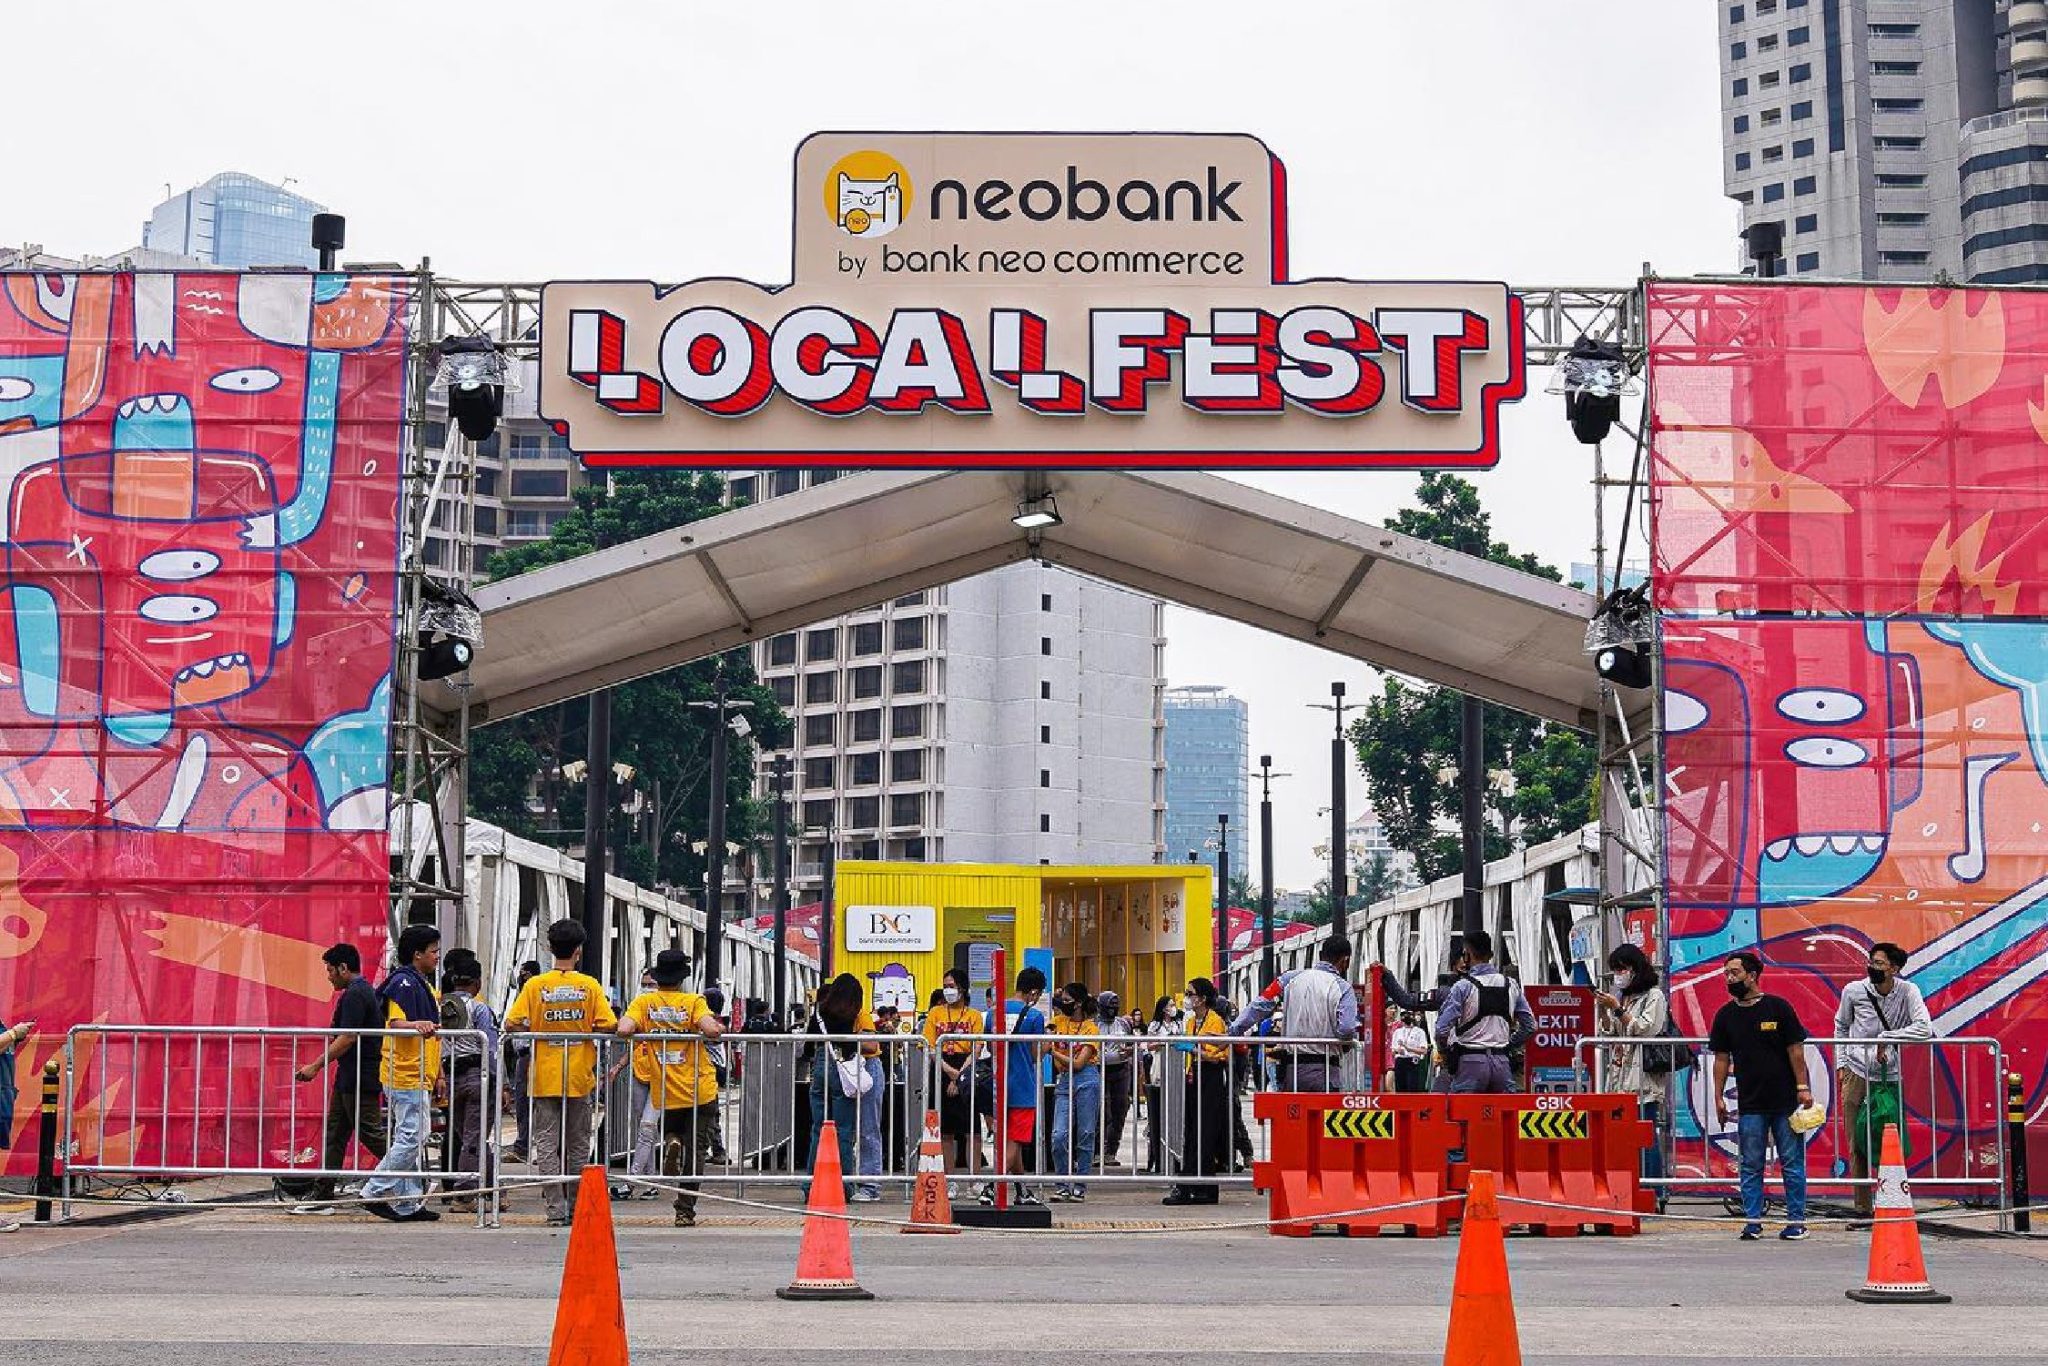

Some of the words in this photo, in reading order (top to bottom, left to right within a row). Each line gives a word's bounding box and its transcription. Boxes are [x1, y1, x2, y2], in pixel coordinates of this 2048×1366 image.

[930, 166, 1244, 222] neobank
[838, 250, 868, 279] by
[882, 243, 971, 273] bank
[978, 251, 1046, 273] neo
[1053, 251, 1245, 275] commerce
[544, 1009, 585, 1020] CREW
[1538, 1015, 1580, 1029] EXIT
[1342, 1095, 1381, 1110] GBK
[1535, 1096, 1573, 1111] GBK
